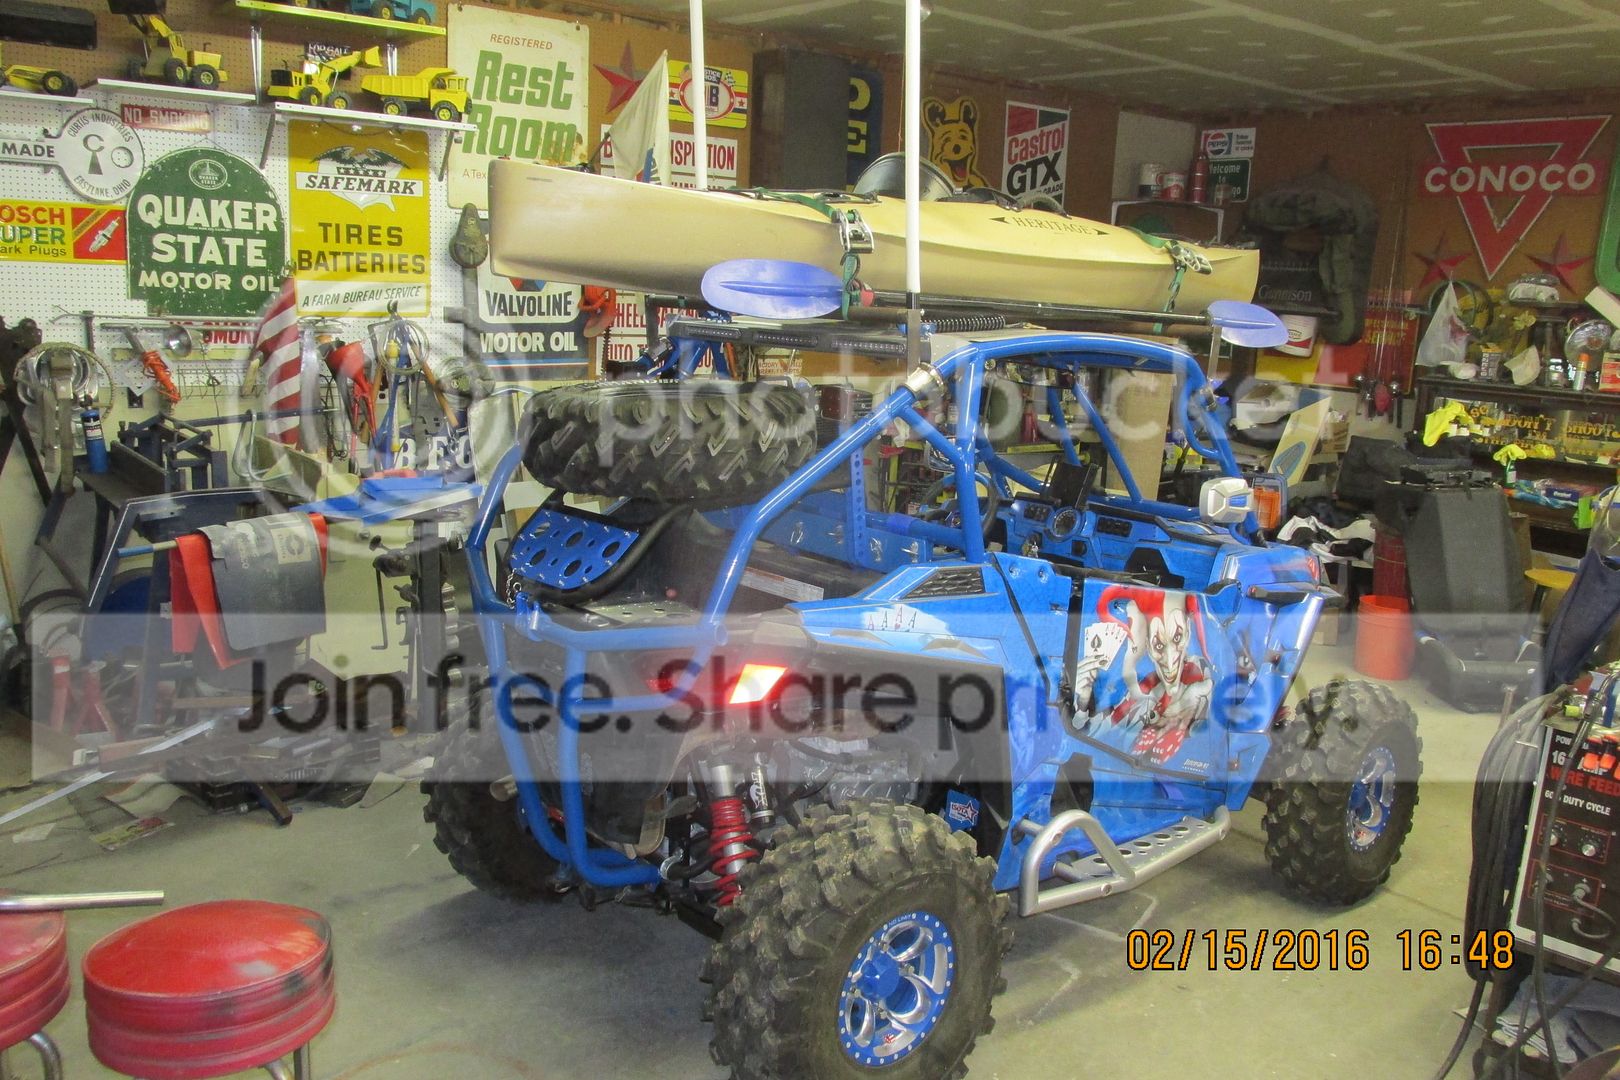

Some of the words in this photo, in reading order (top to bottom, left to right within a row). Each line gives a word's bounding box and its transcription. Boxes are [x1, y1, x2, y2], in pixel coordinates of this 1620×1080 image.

[490, 34, 553, 50] REGISTERED
[472, 50, 574, 110] Rest
[67, 117, 89, 137] CURTIS
[92, 114, 133, 142] INDUSTRIES
[124, 107, 142, 123] NO
[151, 111, 209, 129] SMOKING
[462, 104, 577, 163] Room
[1008, 123, 1065, 166] Castrol
[3, 142, 55, 158] MADE
[671, 140, 734, 170] SPTION
[306, 174, 416, 194] SAFEMARK
[462, 168, 470, 178] A
[472, 170, 487, 180] Tex
[1006, 151, 1062, 196] GTX
[1424, 164, 1596, 193] CONOCO
[74, 176, 112, 197] EASTLAKE,
[113, 179, 131, 195] OHIO
[0, 204, 65, 225] OSCH
[138, 194, 278, 232] QUAKER
[0, 226, 66, 245] UPER
[318, 222, 404, 246] TIRES
[1012, 216, 1092, 235] HERITAGE
[0, 244, 22, 254] ark
[29, 245, 67, 257] Plugs
[152, 233, 266, 267] STATE
[297, 250, 426, 274] BATTERIES
[138, 270, 231, 290] MOTOR
[242, 274, 280, 292] OIL
[302, 296, 310, 308] A
[312, 293, 341, 306] FARM
[342, 289, 383, 304] BUREAU
[384, 286, 422, 300] SERVICE
[486, 290, 572, 316] VALVOLINE
[480, 332, 545, 353] MOTOR
[550, 331, 578, 352] OIL
[1551, 765, 1584, 787] WRE
[1563, 795, 1584, 808] DUTY
[1586, 802, 1611, 816] CYCLE
